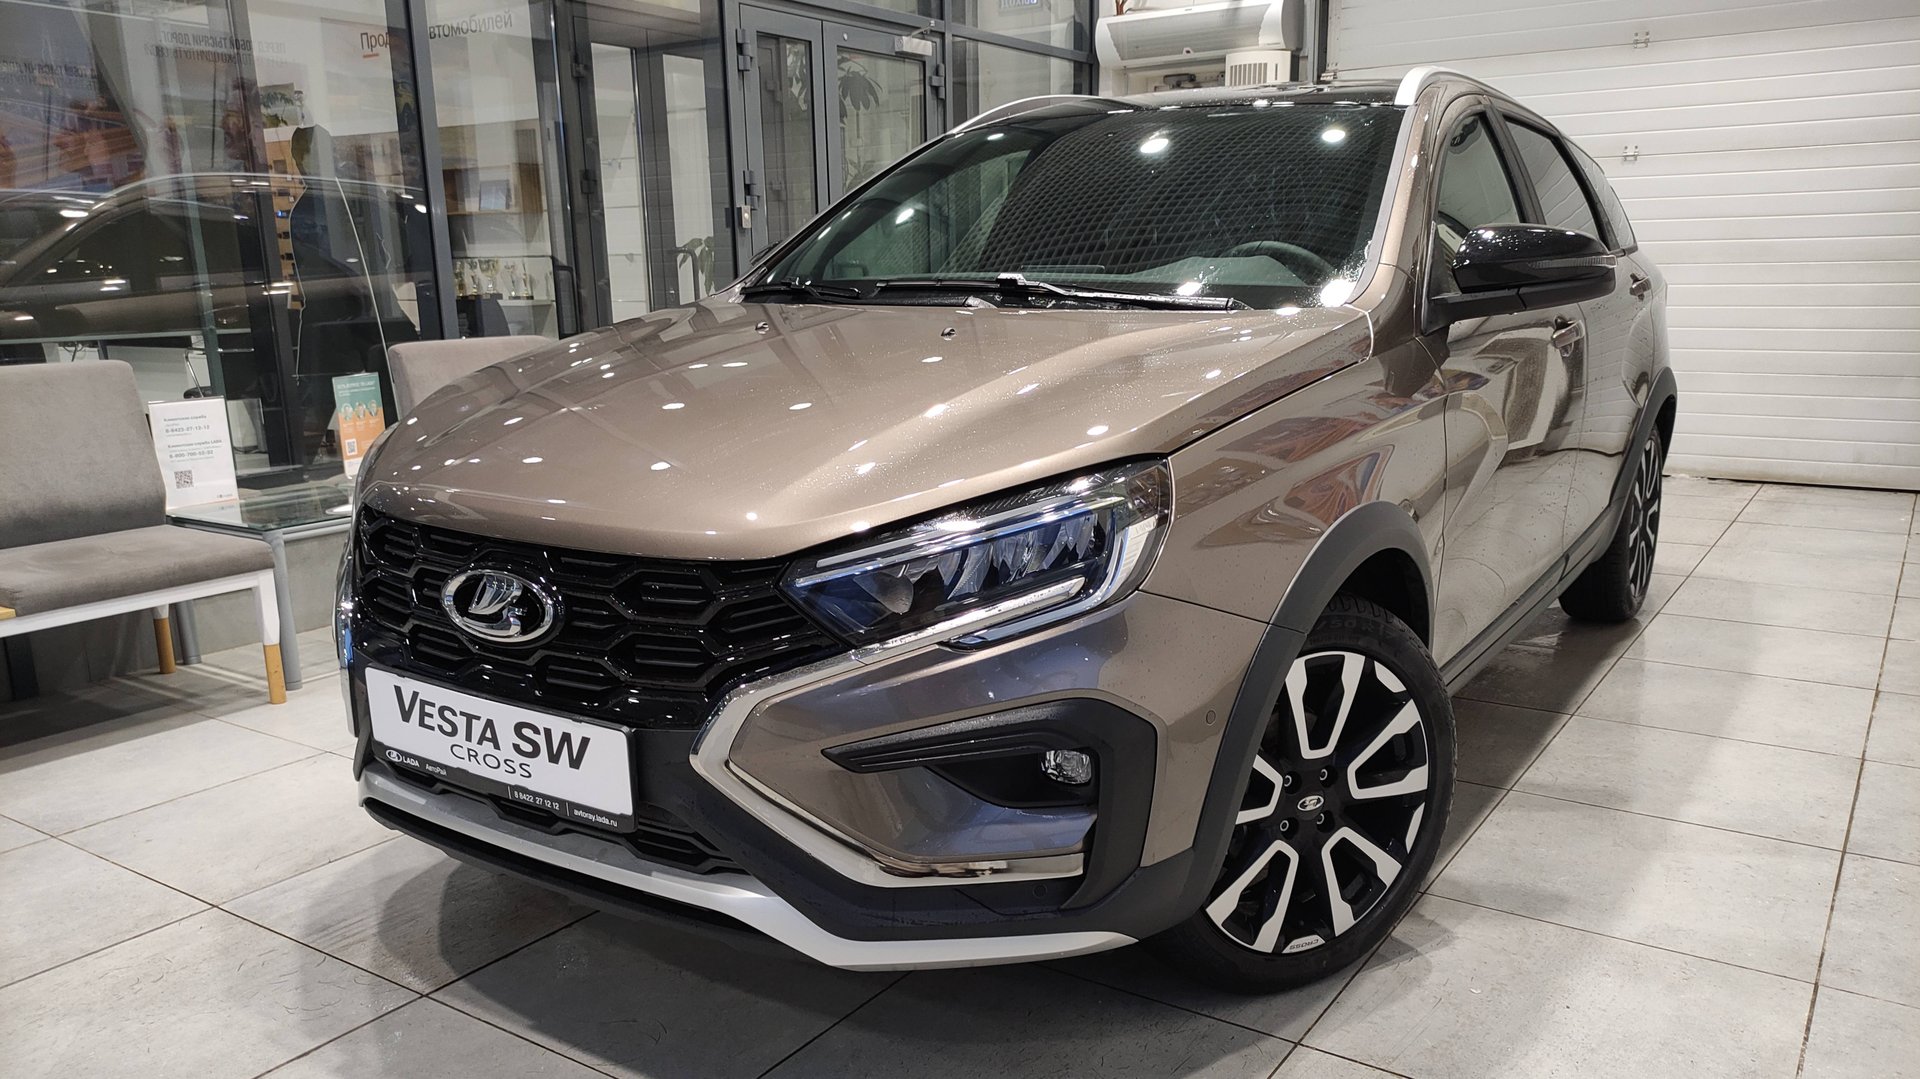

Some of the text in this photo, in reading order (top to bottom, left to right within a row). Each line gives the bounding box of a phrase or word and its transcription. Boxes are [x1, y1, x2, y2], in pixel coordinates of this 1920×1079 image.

[360, 8, 513, 52] Прод втомобилей
[394, 685, 591, 770] VESTA SW
[402, 755, 420, 767] LADA
[450, 744, 532, 779] CROSS
[519, 791, 534, 803] 8422
[535, 796, 543, 805] 27
[544, 799, 552, 808] 12
[552, 801, 560, 811] 12
[573, 808, 618, 827] avtoray.lada.ru
[1289, 939, 1319, 950] CROSS
